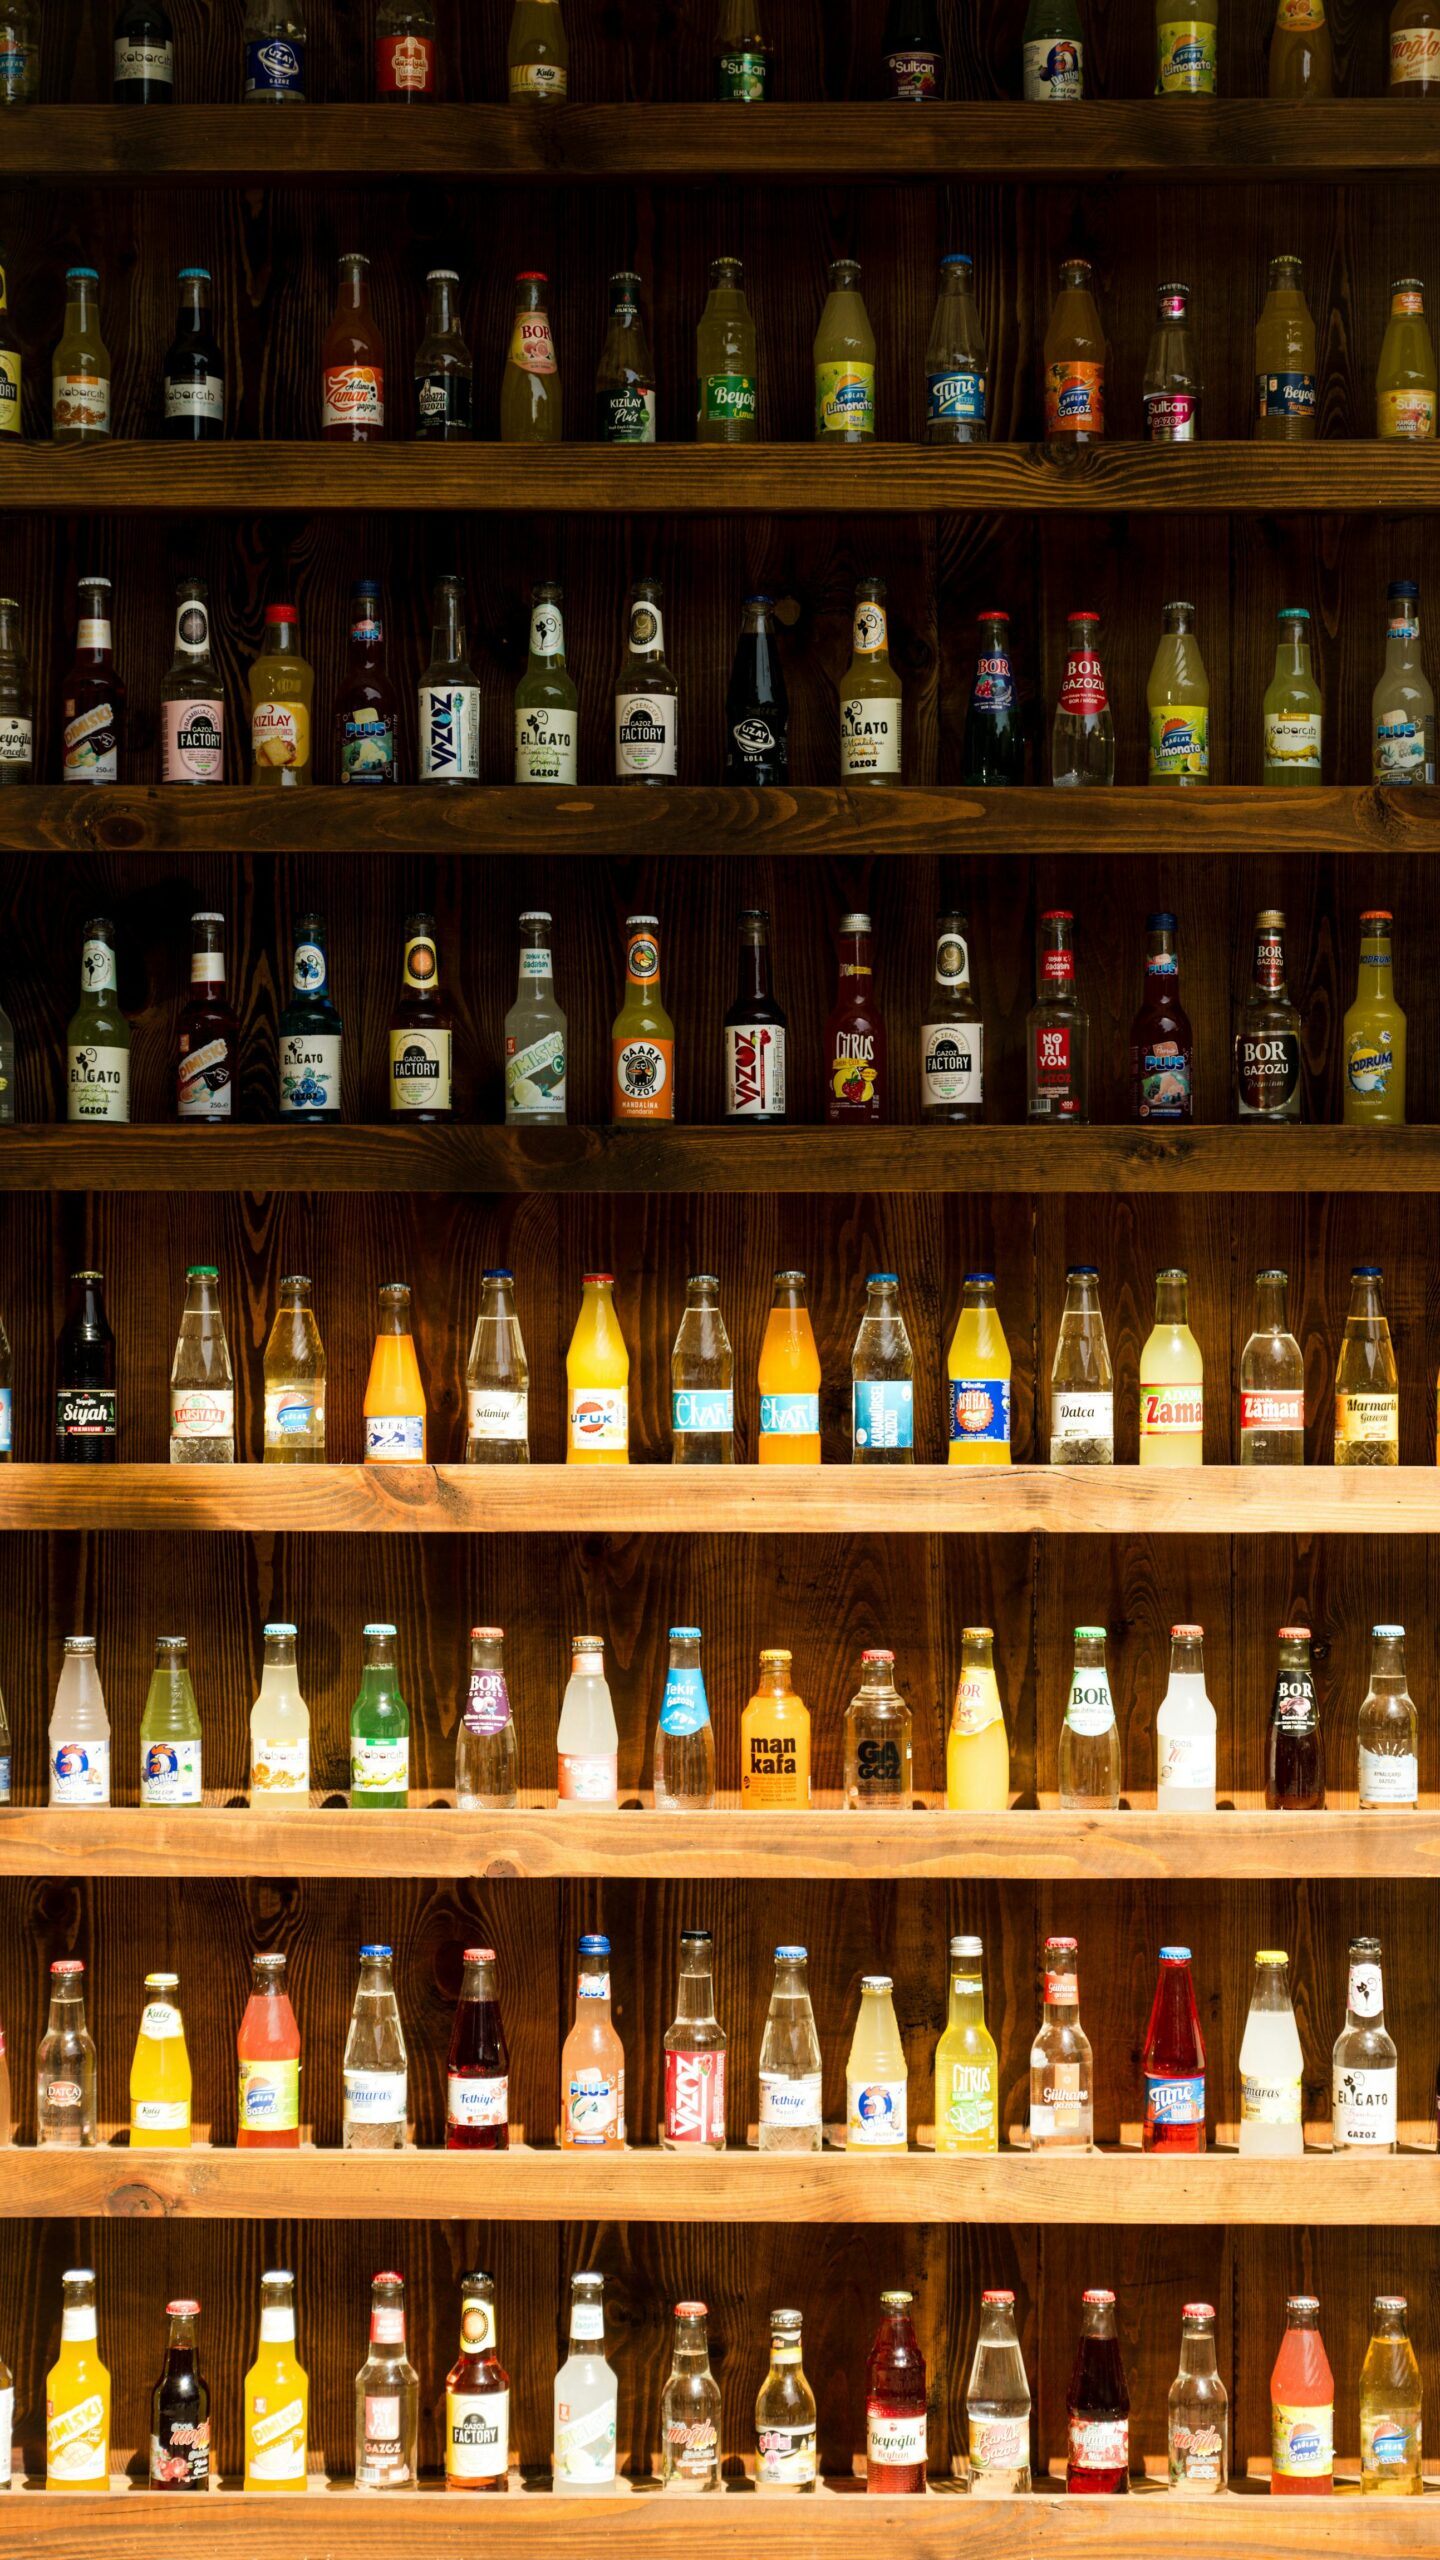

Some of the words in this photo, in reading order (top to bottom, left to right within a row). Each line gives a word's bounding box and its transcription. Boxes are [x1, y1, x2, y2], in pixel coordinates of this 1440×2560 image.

[268, 47, 293, 65] UZAY
[728, 63, 766, 76] Sultan
[895, 60, 935, 74] Sultan
[1163, 61, 1211, 77] Limonata
[521, 325, 550, 340] BOR
[326, 378, 369, 406] Zaman
[932, 379, 977, 406] Tunç
[610, 399, 643, 409] KIZILAY
[826, 401, 873, 415] Limonata
[1058, 404, 1092, 417] Gazoz
[1147, 400, 1189, 416] Sultan
[614, 407, 640, 424] Plus
[1152, 417, 1184, 427] GAZOZ
[351, 629, 379, 641] PLUS
[1386, 627, 1413, 639] PLUS
[978, 659, 1011, 676] BOR
[1067, 661, 1102, 677] BOR
[1062, 678, 1105, 691] GAZOZU
[254, 715, 291, 728] KIZILAY
[630, 719, 652, 727] GAZOZ
[345, 721, 388, 737] PLUS
[621, 727, 663, 741] FACTORY
[742, 726, 768, 740] UZAY
[841, 724, 851, 738] EL
[855, 722, 888, 737] GATO
[1376, 722, 1417, 738] PLUS
[180, 733, 221, 747] FACTORY
[521, 732, 532, 745] EL
[538, 732, 571, 746] GATO
[1153, 743, 1201, 759] Limonata
[849, 759, 878, 769] GAZOZ
[530, 768, 559, 778] GAZOZ
[1257, 945, 1283, 958] BOR
[1256, 958, 1283, 966] GAZOZU
[1148, 964, 1176, 975] PLUS
[1042, 1033, 1063, 1044] NO
[622, 1046, 662, 1063] GAARK
[1044, 1045, 1059, 1055] RI
[1243, 1041, 1287, 1062] BOR
[284, 1054, 295, 1065] EL
[297, 1053, 323, 1064] GATO
[927, 1056, 970, 1071] FACTORY
[1039, 1056, 1067, 1066] YON
[1145, 1056, 1185, 1070] PLUS
[395, 1062, 438, 1077] FACTORY
[1243, 1063, 1289, 1076] GAZOZU
[71, 1070, 82, 1083] EL
[87, 1070, 121, 1084] GATO
[624, 1084, 657, 1098] GAZOZ
[79, 1106, 108, 1115] GAZOZ
[64, 1404, 108, 1425] Siyah
[475, 1408, 511, 1421] Selimiye
[1245, 1397, 1299, 1418] Zaman
[571, 1414, 613, 1424] UFUK
[869, 1385, 885, 1447] KARAMÜRSEL
[885, 1409, 898, 1447] GAZOZU
[469, 1675, 502, 1691] BOR
[666, 1683, 699, 1697] Tekir
[1279, 1682, 1313, 1698] BOR
[1072, 1687, 1110, 1705] BOR
[751, 1737, 797, 1753] man
[751, 1753, 797, 1774] kafa
[571, 2081, 611, 2096] PLUS
[1044, 2087, 1088, 2102] Gülhane
[460, 2093, 496, 2106] Fethiye
[771, 2095, 807, 2107] Fethiye
[1338, 2090, 1348, 2104] EL
[1355, 2092, 1388, 2106] GATO
[1347, 2130, 1377, 2139] GAZOZ
[454, 2429, 498, 2443] FACTORY
[871, 2431, 916, 2451] Beyoğlu
[365, 2443, 402, 2453] GAZOZ
